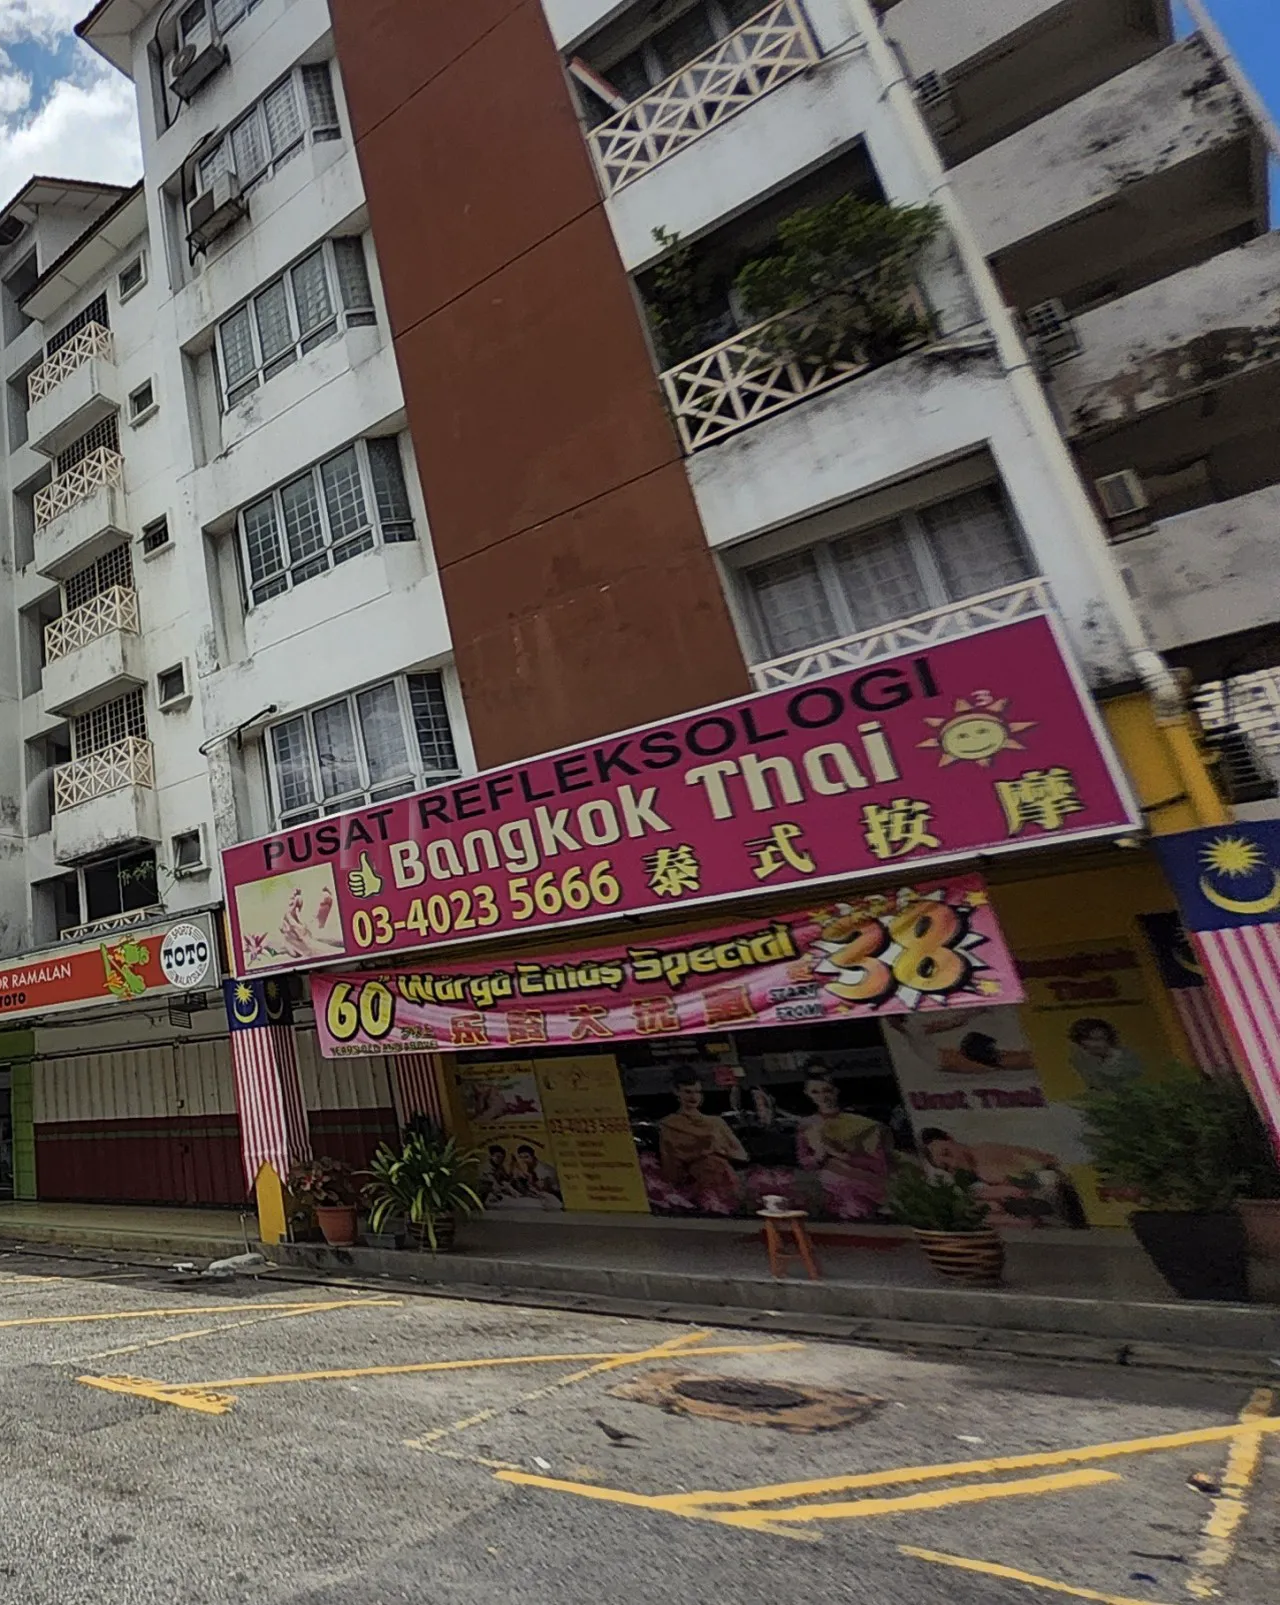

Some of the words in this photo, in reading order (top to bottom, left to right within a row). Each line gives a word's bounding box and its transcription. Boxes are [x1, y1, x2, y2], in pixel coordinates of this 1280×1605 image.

[263, 804, 397, 868] PUSAT
[417, 657, 941, 826] REFLEKSOLOGI
[391, 781, 672, 892] Bangkok
[685, 720, 898, 825] Thai
[646, 766, 1085, 896] 泰式按摩
[162, 941, 208, 970] TOTO
[351, 883, 500, 949] 03-4023
[508, 860, 620, 915] 5666
[818, 898, 971, 1005] 38
[11, 962, 72, 990] RAMALAN
[325, 979, 396, 1041] 60
[396, 968, 513, 1008] Warga
[628, 920, 800, 988] Special
